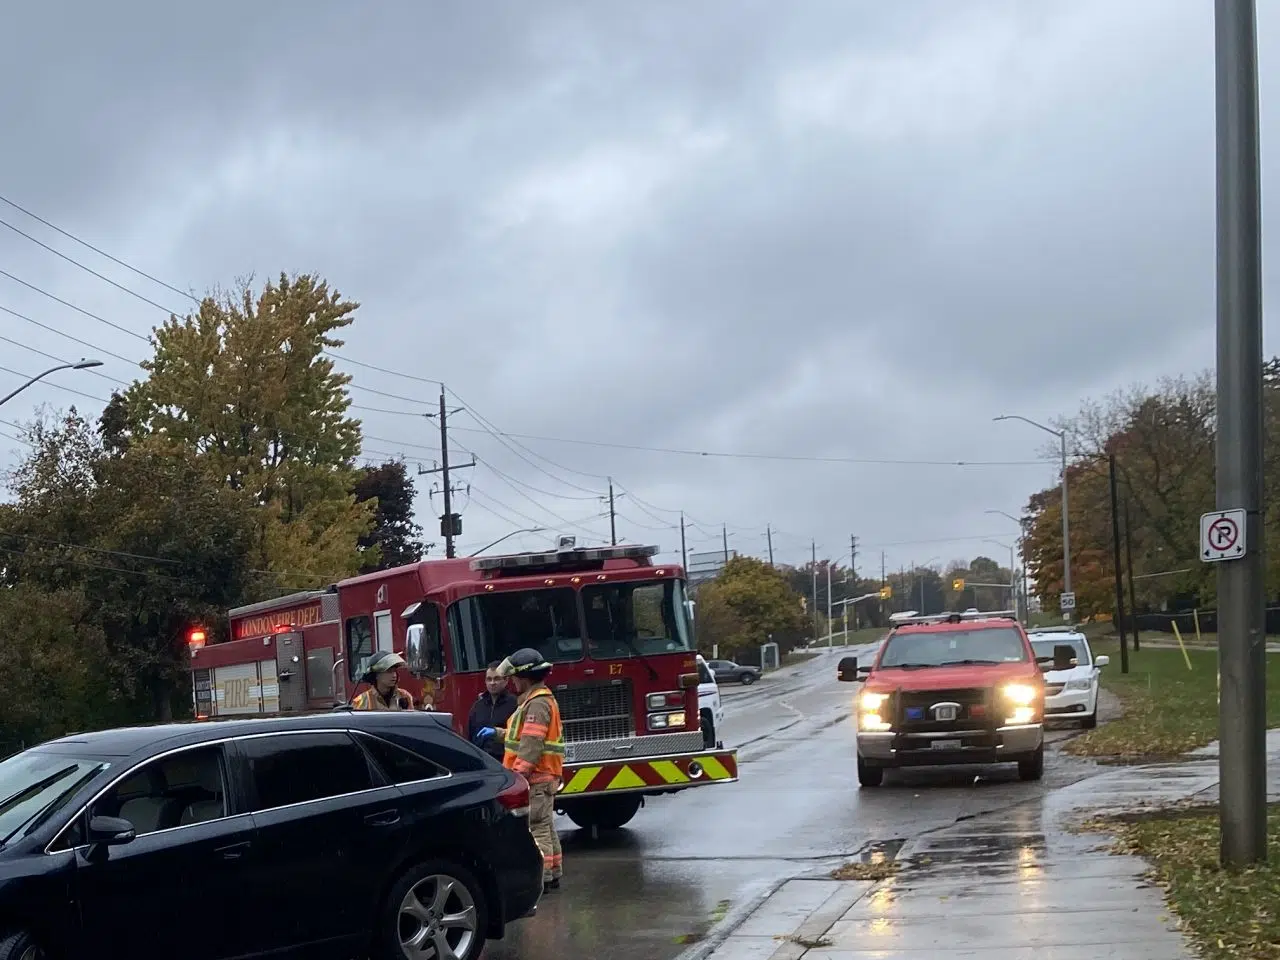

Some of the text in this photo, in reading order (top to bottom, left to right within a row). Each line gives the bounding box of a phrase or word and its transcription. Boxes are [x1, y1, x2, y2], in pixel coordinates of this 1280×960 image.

[1062, 598, 1074, 606] 50
[240, 615, 276, 637] LONDON
[609, 663, 623, 675] E7
[223, 677, 249, 708] FIRE
